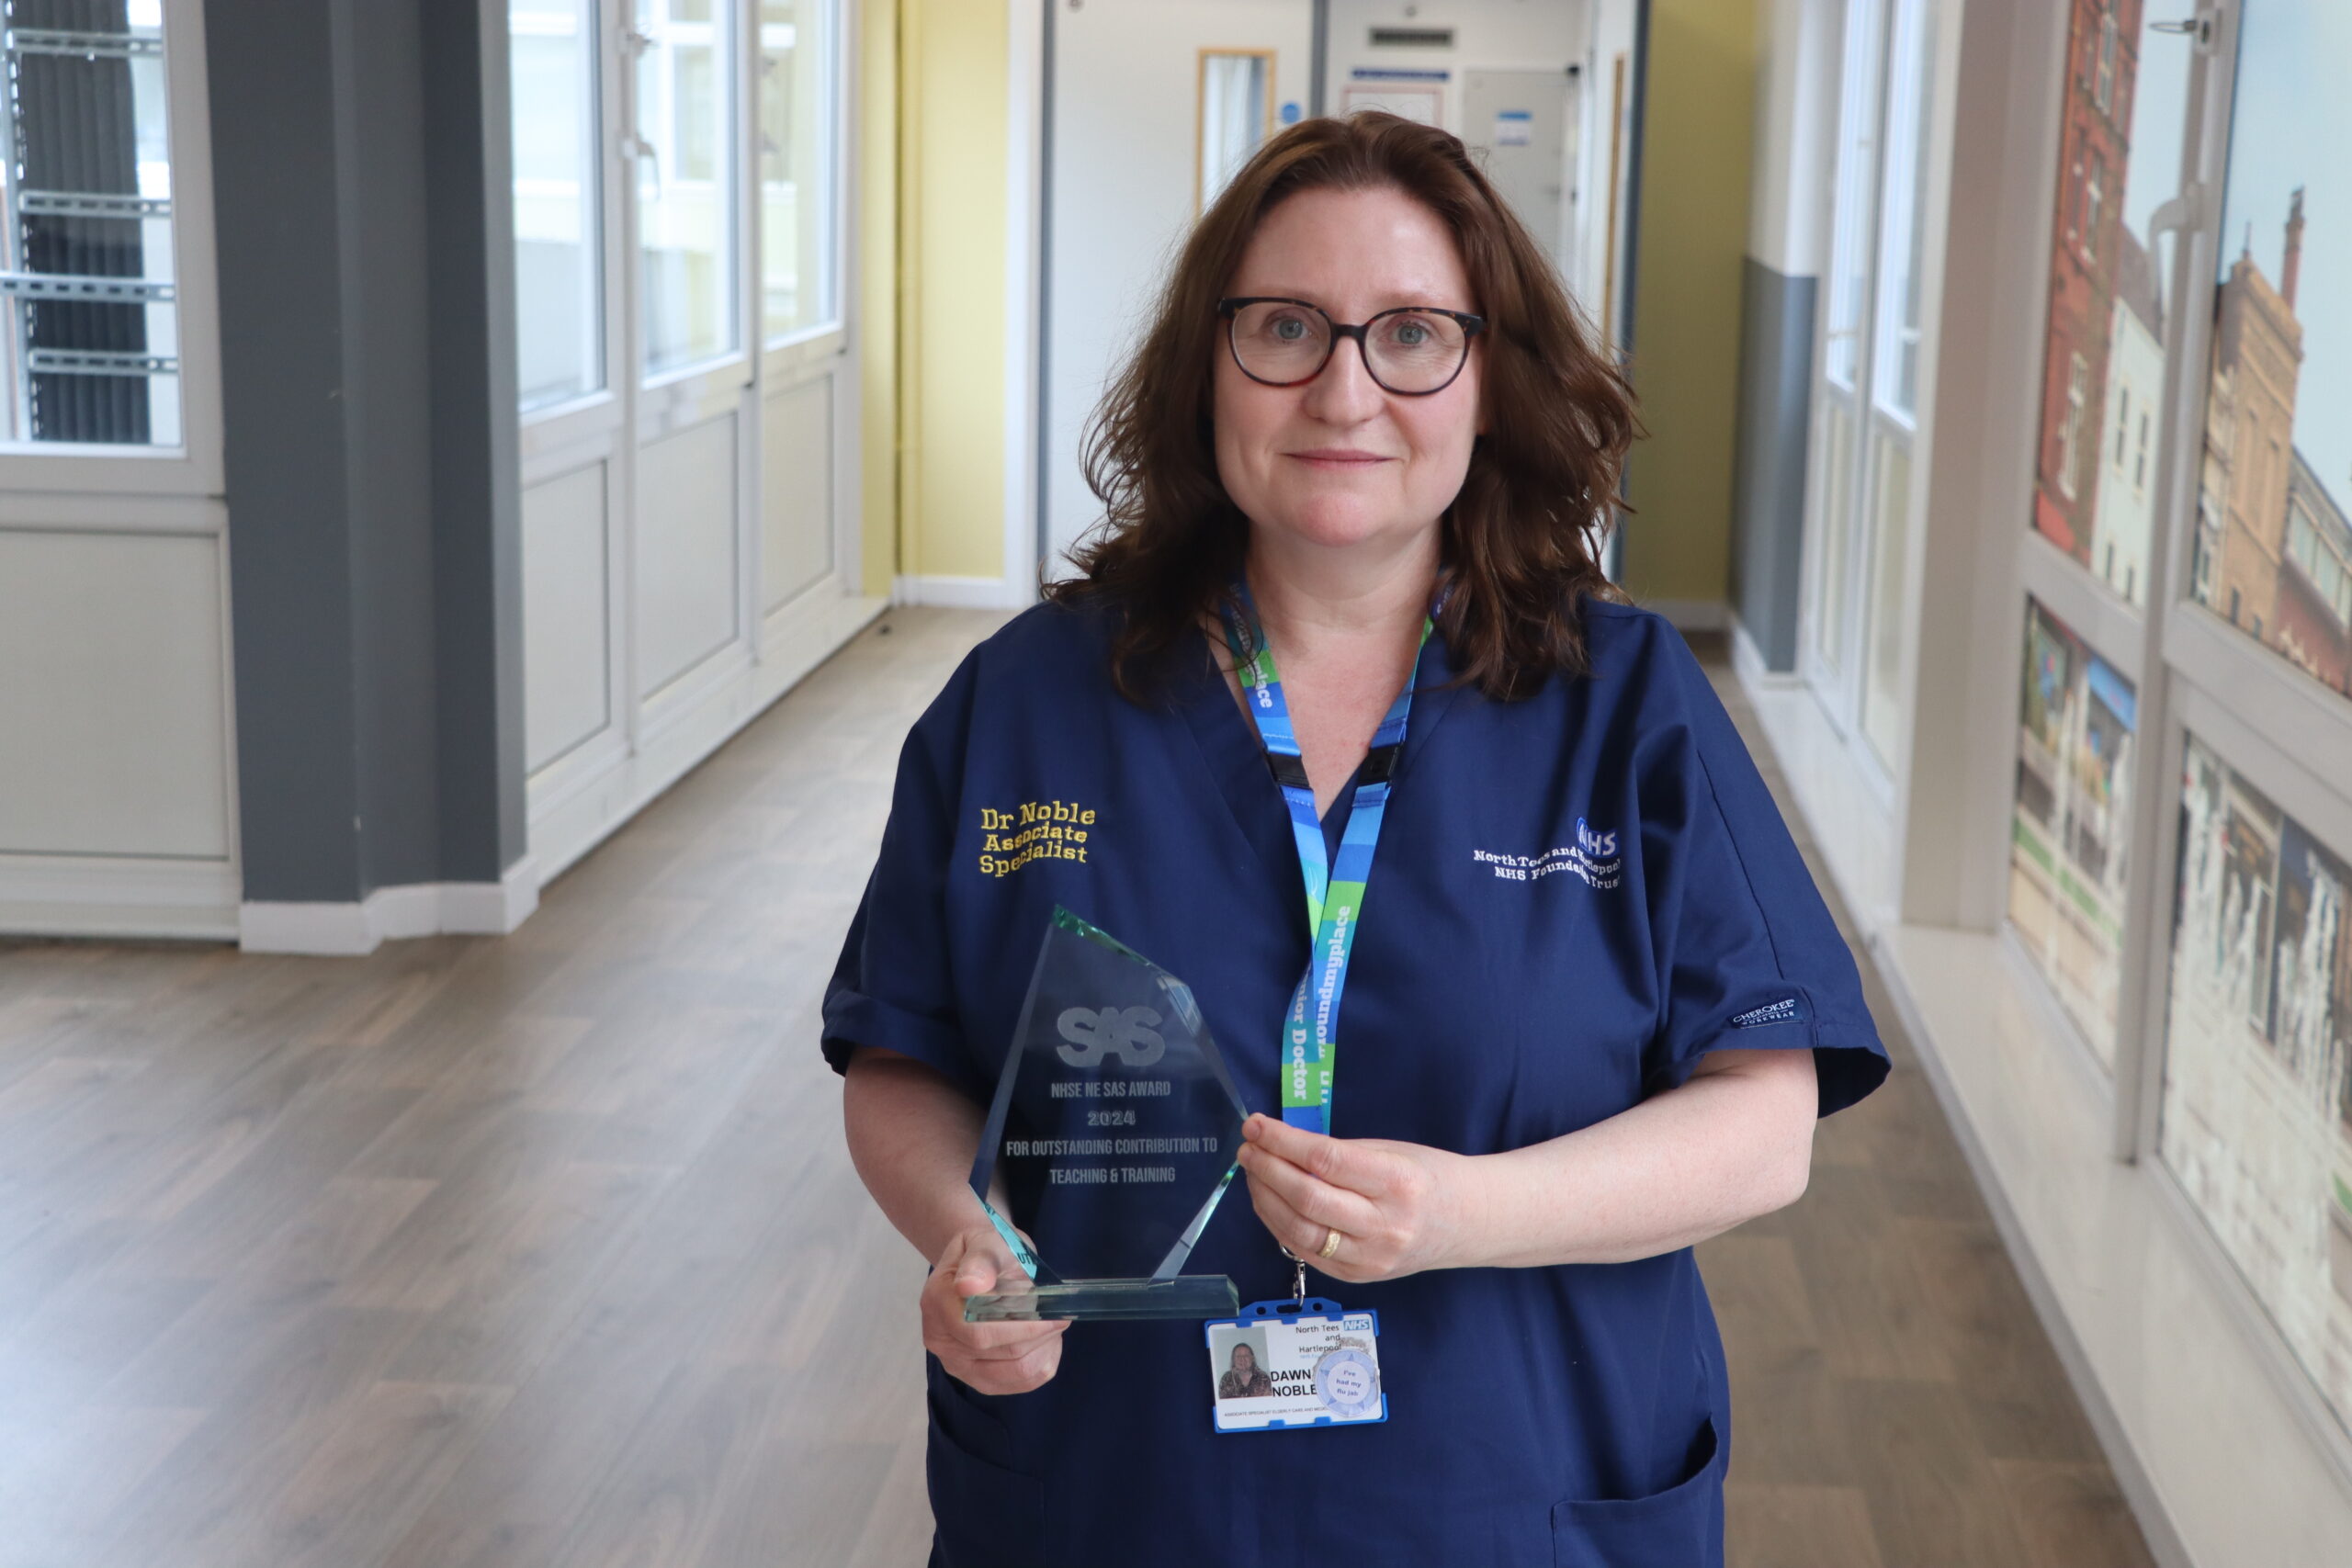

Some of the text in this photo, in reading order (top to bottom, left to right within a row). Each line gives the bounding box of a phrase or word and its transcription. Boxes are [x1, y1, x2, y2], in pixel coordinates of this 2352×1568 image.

[980, 800, 1096, 830] Dr Noble
[982, 820, 1088, 852] Associate
[1577, 822, 1617, 856] NHS
[979, 840, 1088, 877] Specialist
[1473, 850, 1518, 866] North
[1552, 846, 1577, 857] and
[1494, 866, 1526, 881] NHS
[1733, 998, 1795, 1022] CHEROKEE
[1057, 1005, 1165, 1067] SAS
[1292, 1028, 1308, 1100] Doctor
[1050, 1081, 1171, 1098] NHSE NE SAS AWARD
[1087, 1110, 1136, 1126] 2024
[1006, 1137, 1218, 1156] FOR OUTSTANDING CONTRIBUTION TO
[1050, 1167, 1176, 1185] TEACHING & TRAINING
[1295, 1325, 1319, 1334] North
[1343, 1319, 1370, 1331] NHS
[1325, 1334, 1341, 1342] and
[1270, 1369, 1312, 1382] DAWN
[1272, 1385, 1317, 1397] NOBLE
